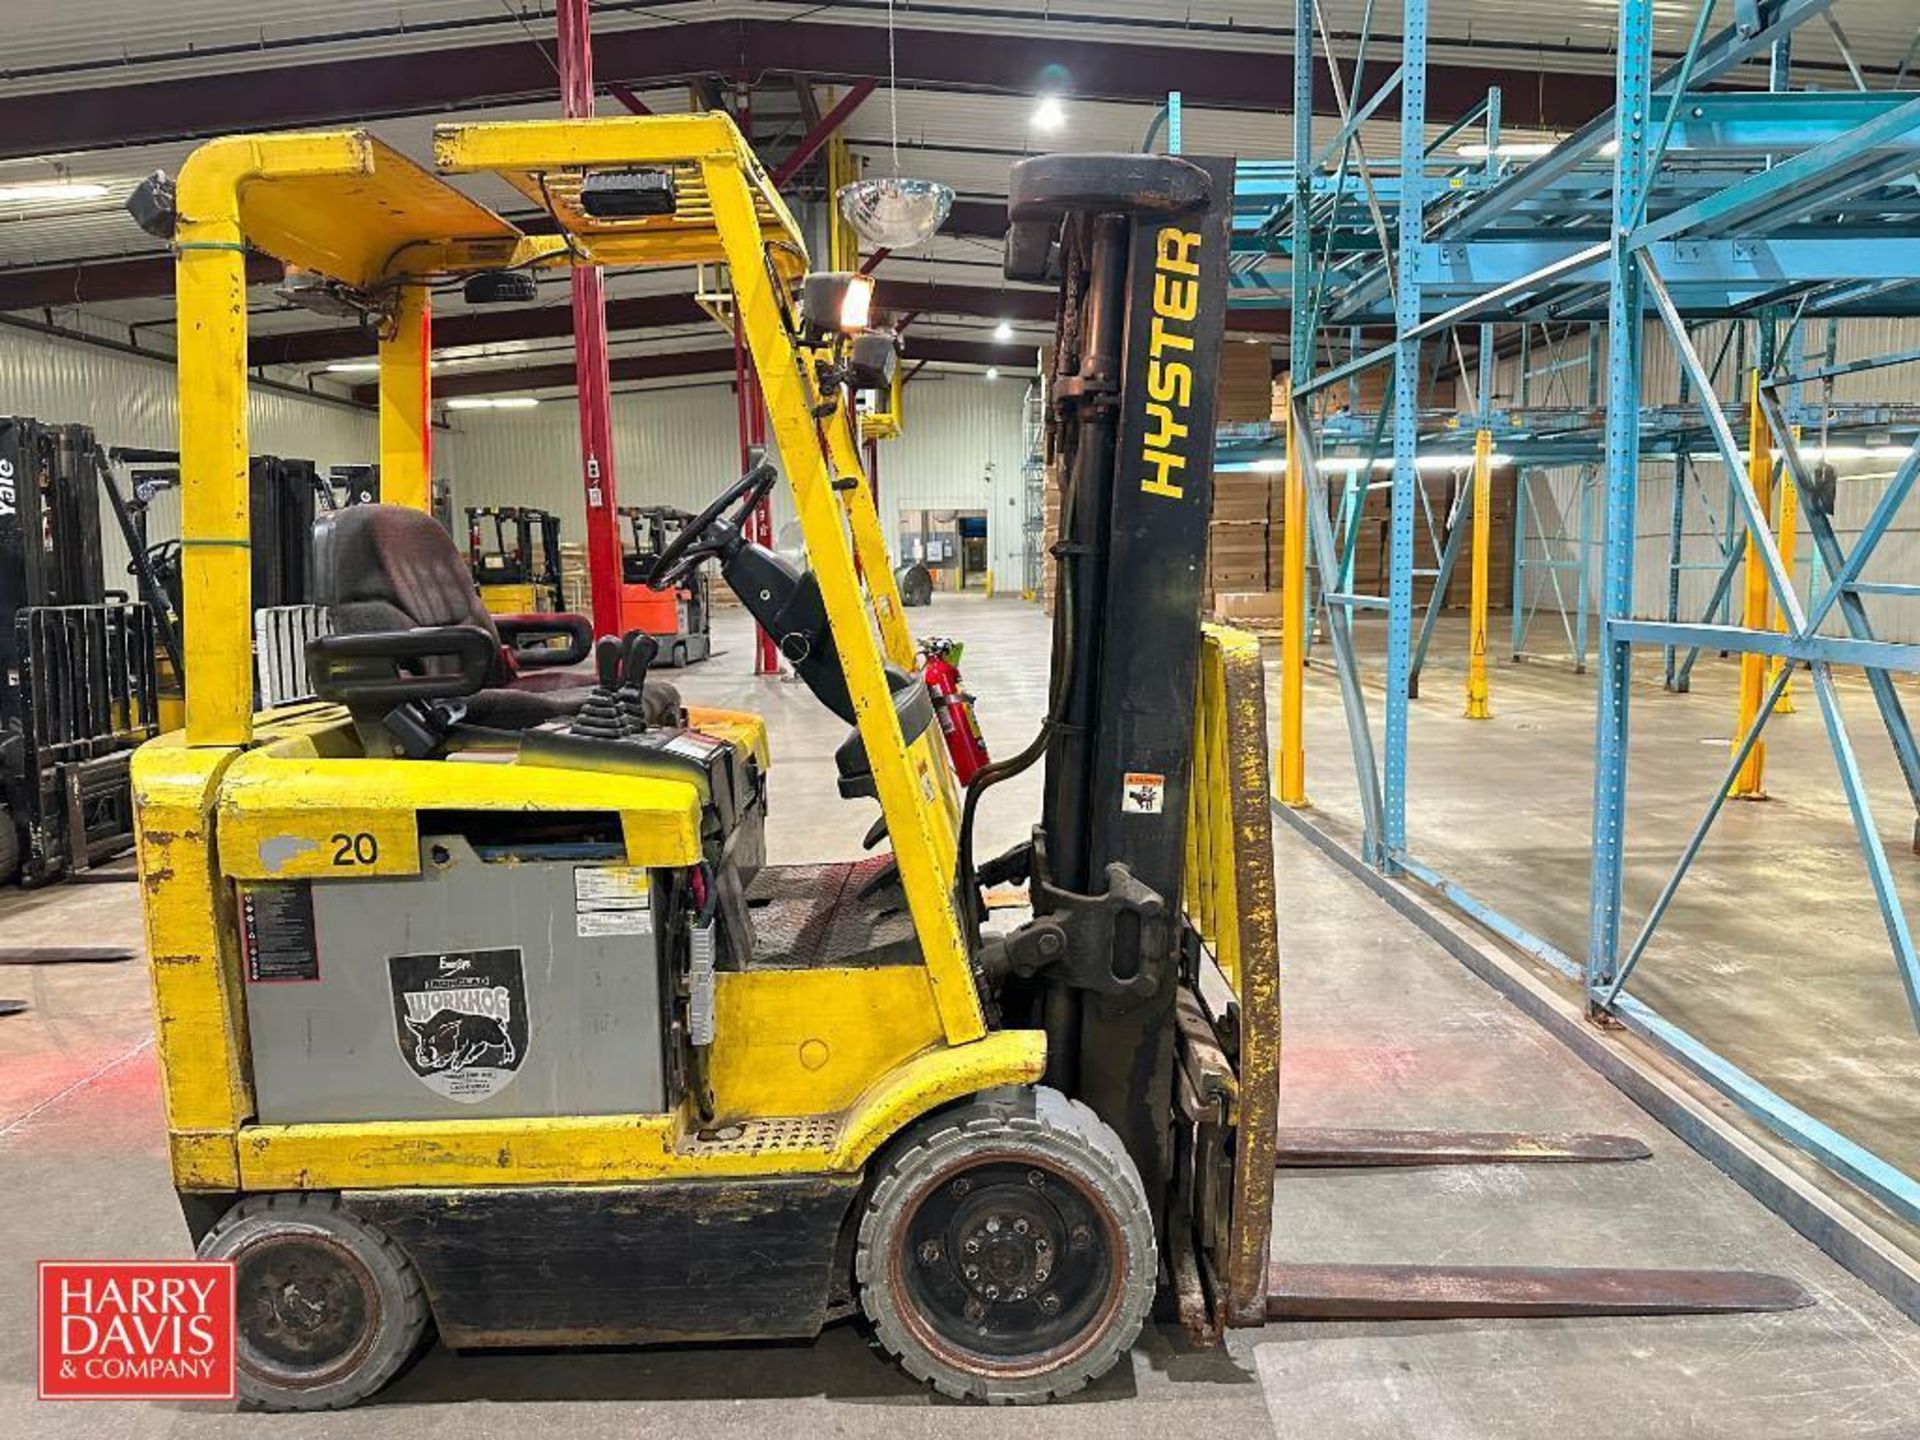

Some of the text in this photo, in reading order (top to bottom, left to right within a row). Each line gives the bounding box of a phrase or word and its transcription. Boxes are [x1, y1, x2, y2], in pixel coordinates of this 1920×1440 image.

[1141, 227, 1201, 499] HYSTER
[0, 458, 16, 515] Yale
[330, 832, 377, 865] 20
